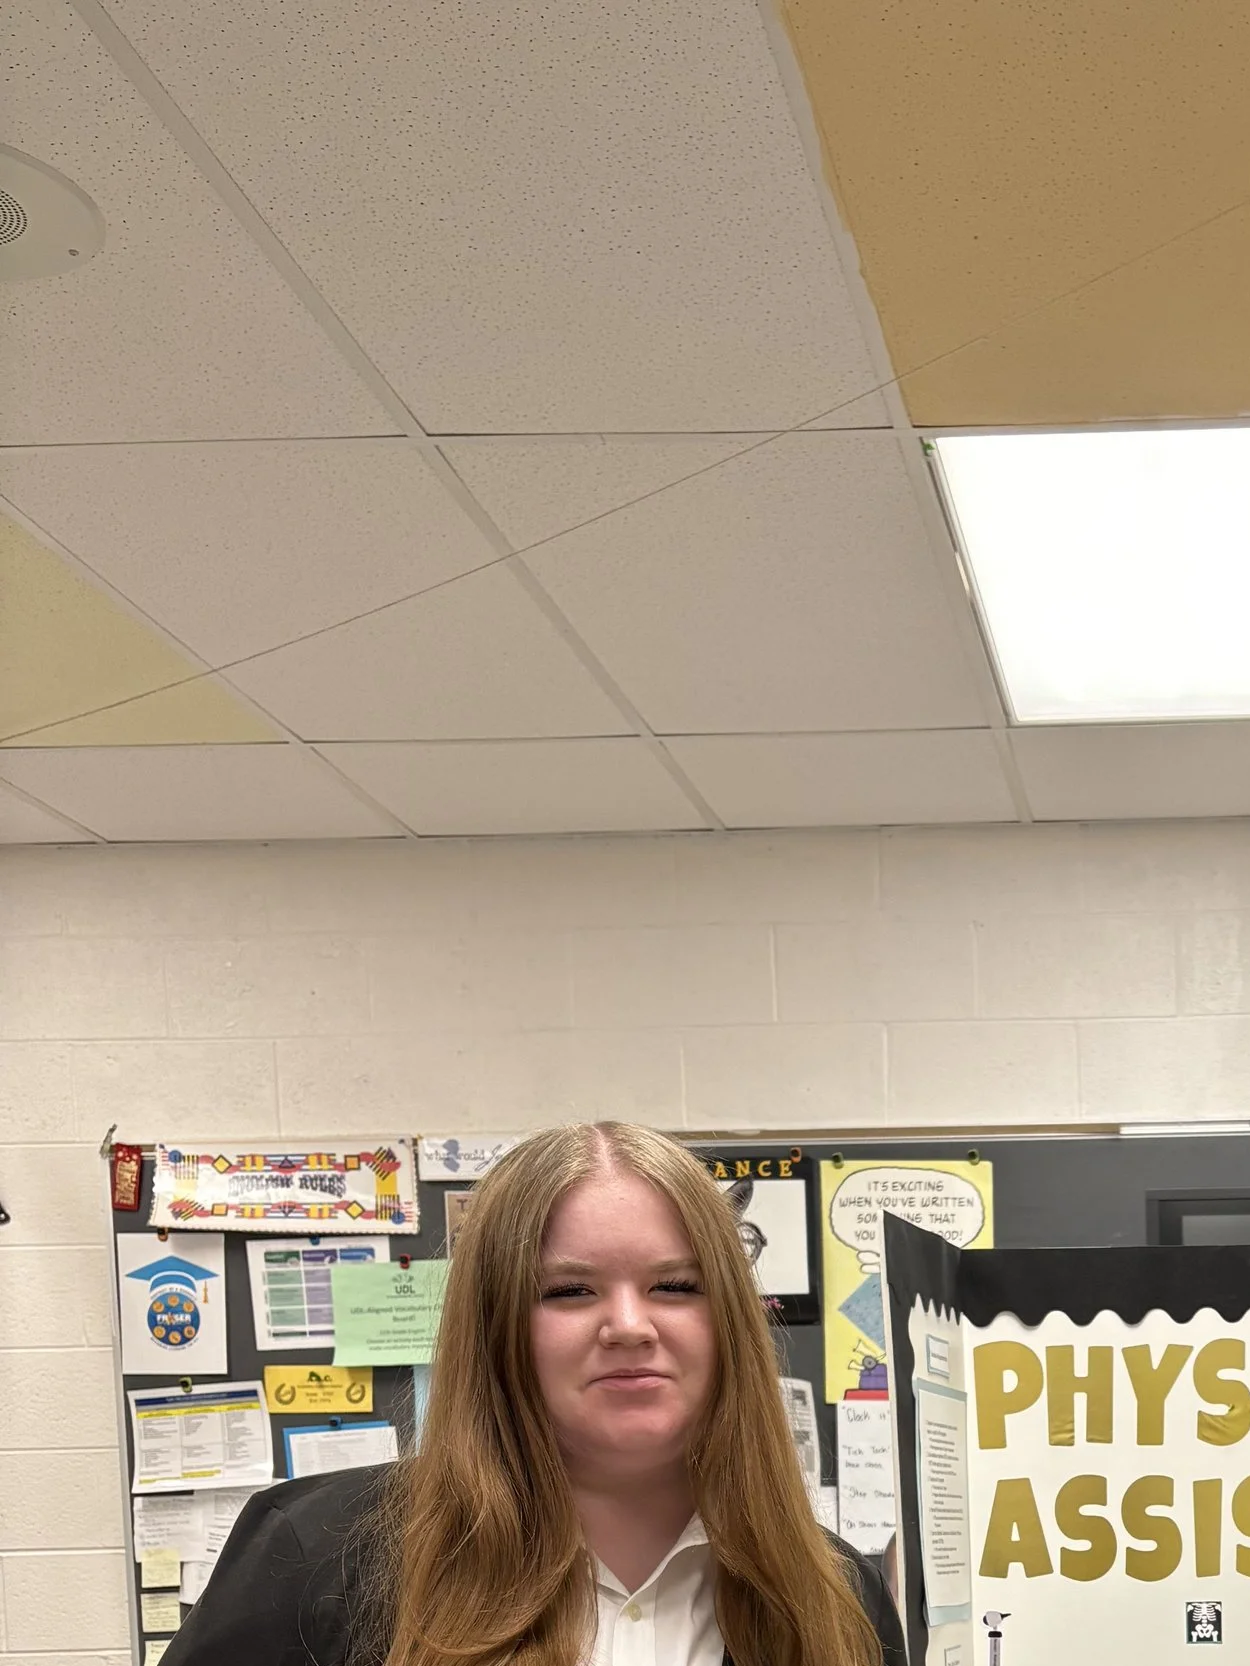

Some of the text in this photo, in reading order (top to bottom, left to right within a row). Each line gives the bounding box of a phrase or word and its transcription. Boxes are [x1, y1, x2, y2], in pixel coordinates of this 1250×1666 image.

[715, 1159, 793, 1179] ANCE
[299, 1174, 347, 1199] RULES
[892, 1180, 945, 1192] EXCITING
[839, 1196, 975, 1208] WHEN YOU'VE WRITTEN
[929, 1212, 956, 1224] THAT
[854, 1229, 876, 1242] YOU
[394, 1285, 416, 1294] UDL
